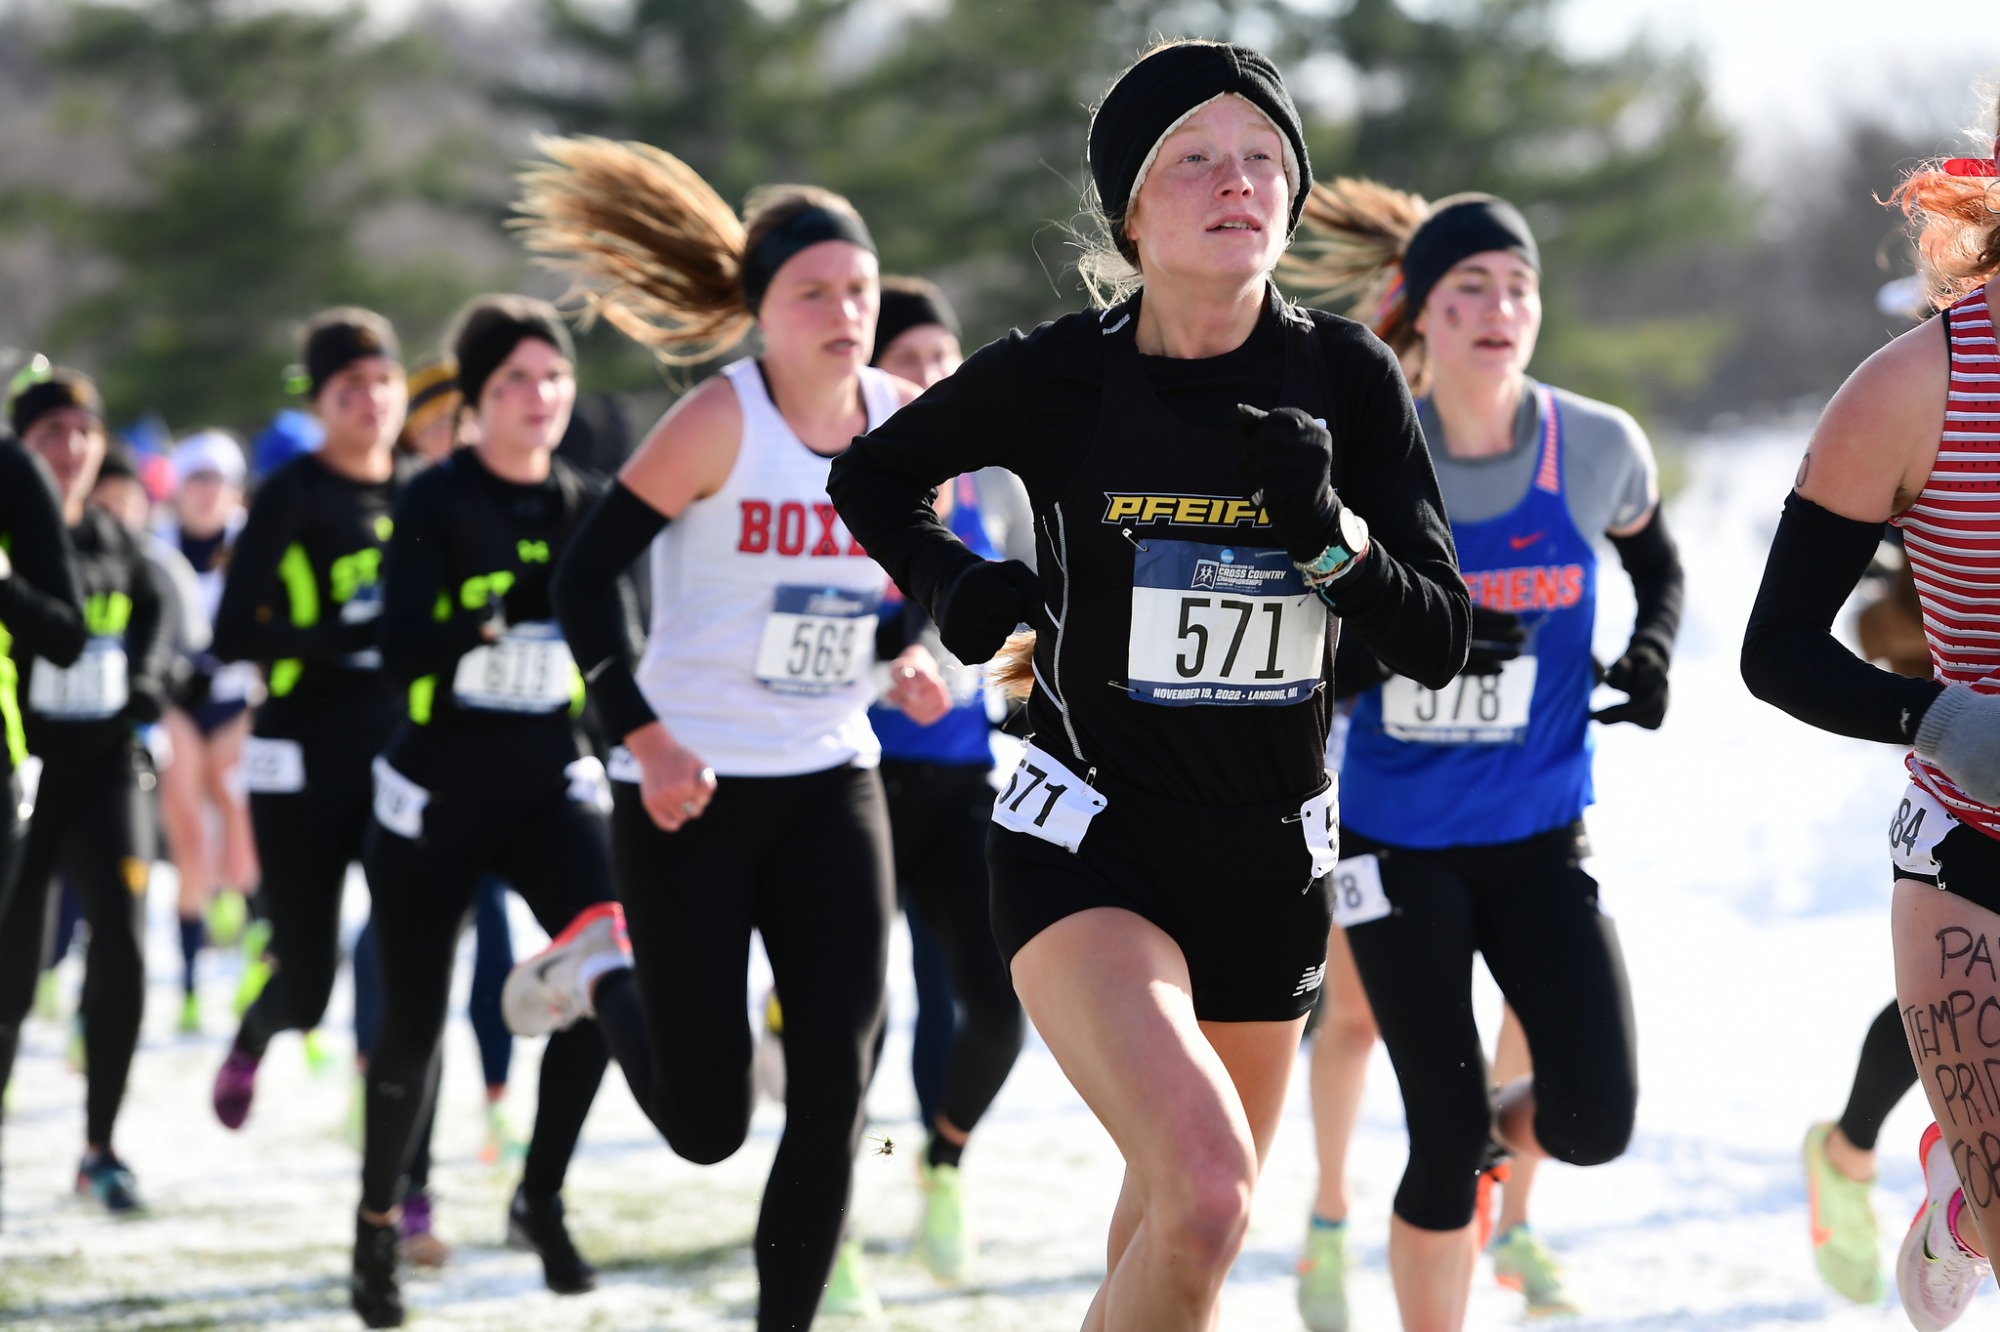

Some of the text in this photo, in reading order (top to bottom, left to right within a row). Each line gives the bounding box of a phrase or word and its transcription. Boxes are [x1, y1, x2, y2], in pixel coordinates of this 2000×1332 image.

[1217, 575, 1264, 586] CHAMPIONSHIPS
[1218, 567, 1287, 580] CROSS COUNTRY
[1175, 597, 1284, 679] 571
[1153, 686, 1299, 701] NOVEMBER 19, 2022 LANSING, MI
[1935, 926, 2000, 982] PA
